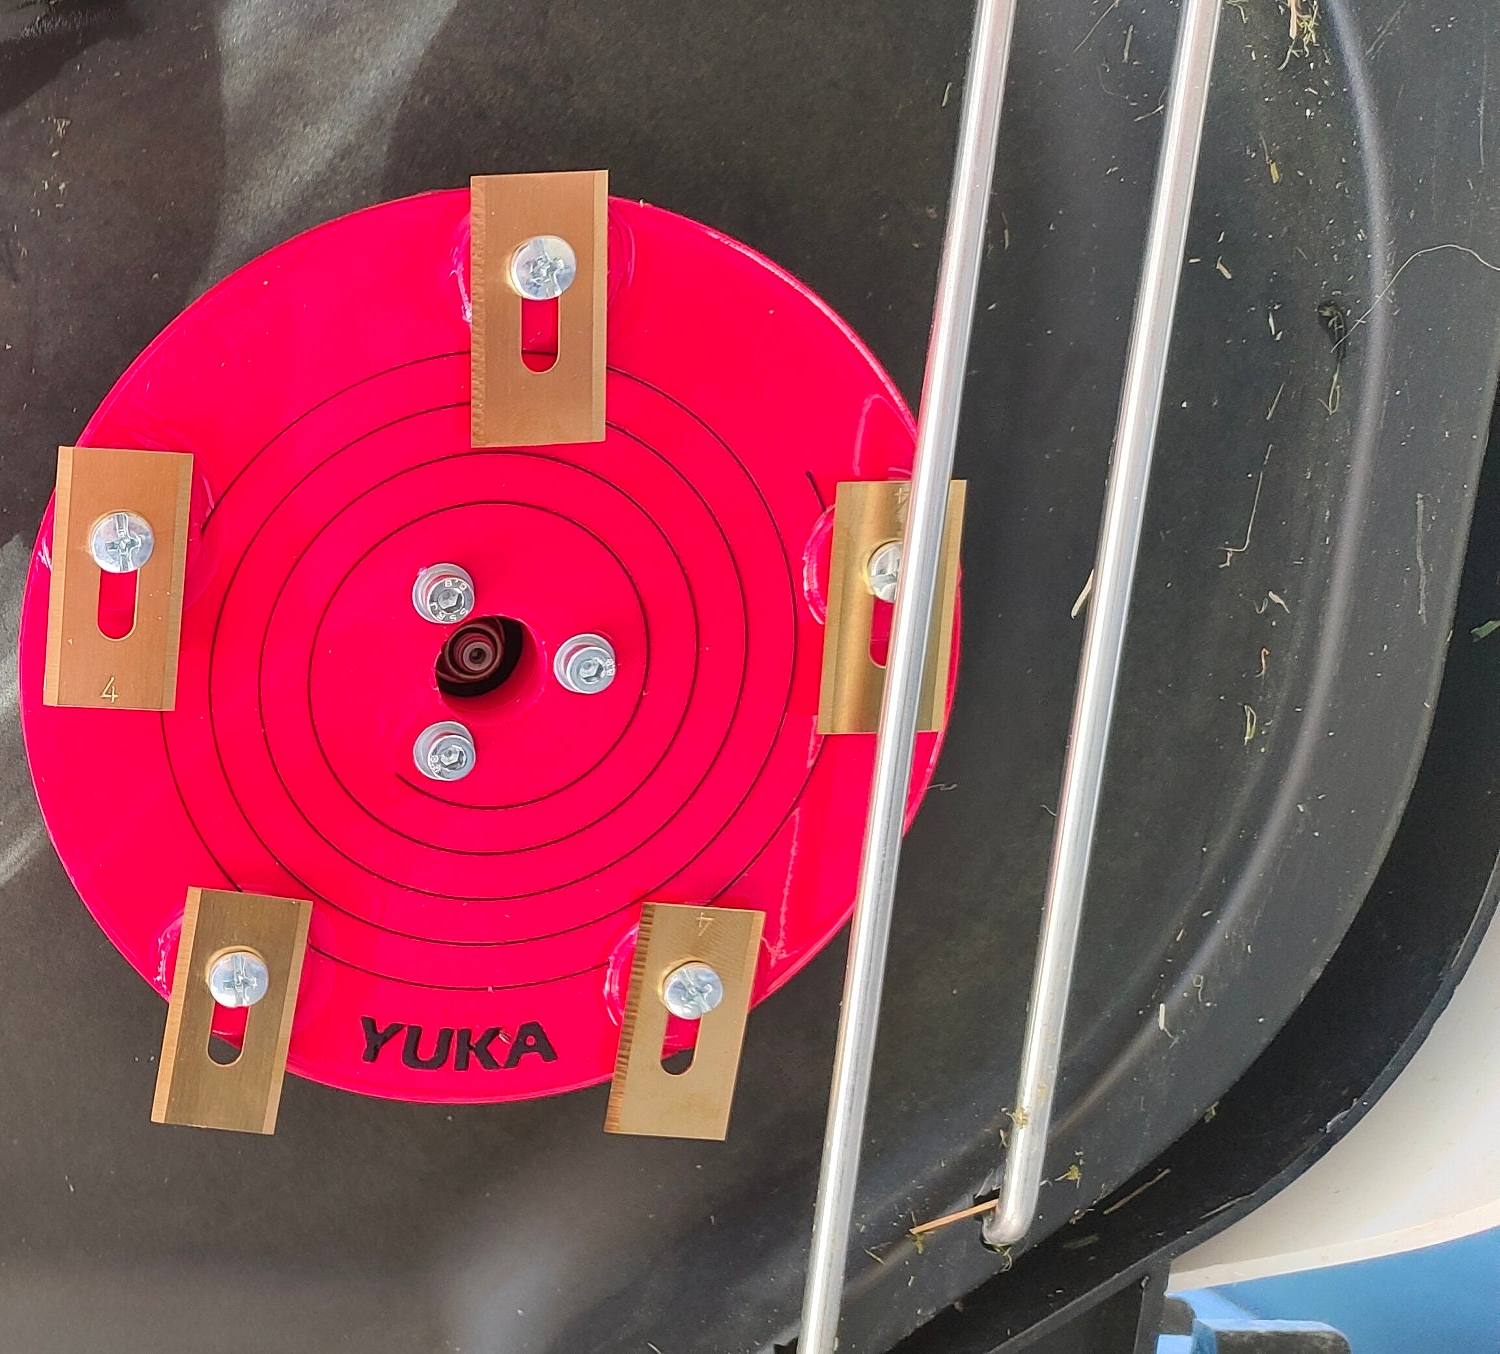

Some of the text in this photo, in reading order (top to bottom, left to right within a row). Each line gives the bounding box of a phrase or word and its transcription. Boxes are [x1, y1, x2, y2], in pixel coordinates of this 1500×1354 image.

[100, 676, 119, 704] 4
[695, 911, 714, 937] 4
[361, 1015, 559, 1071] YUKA
